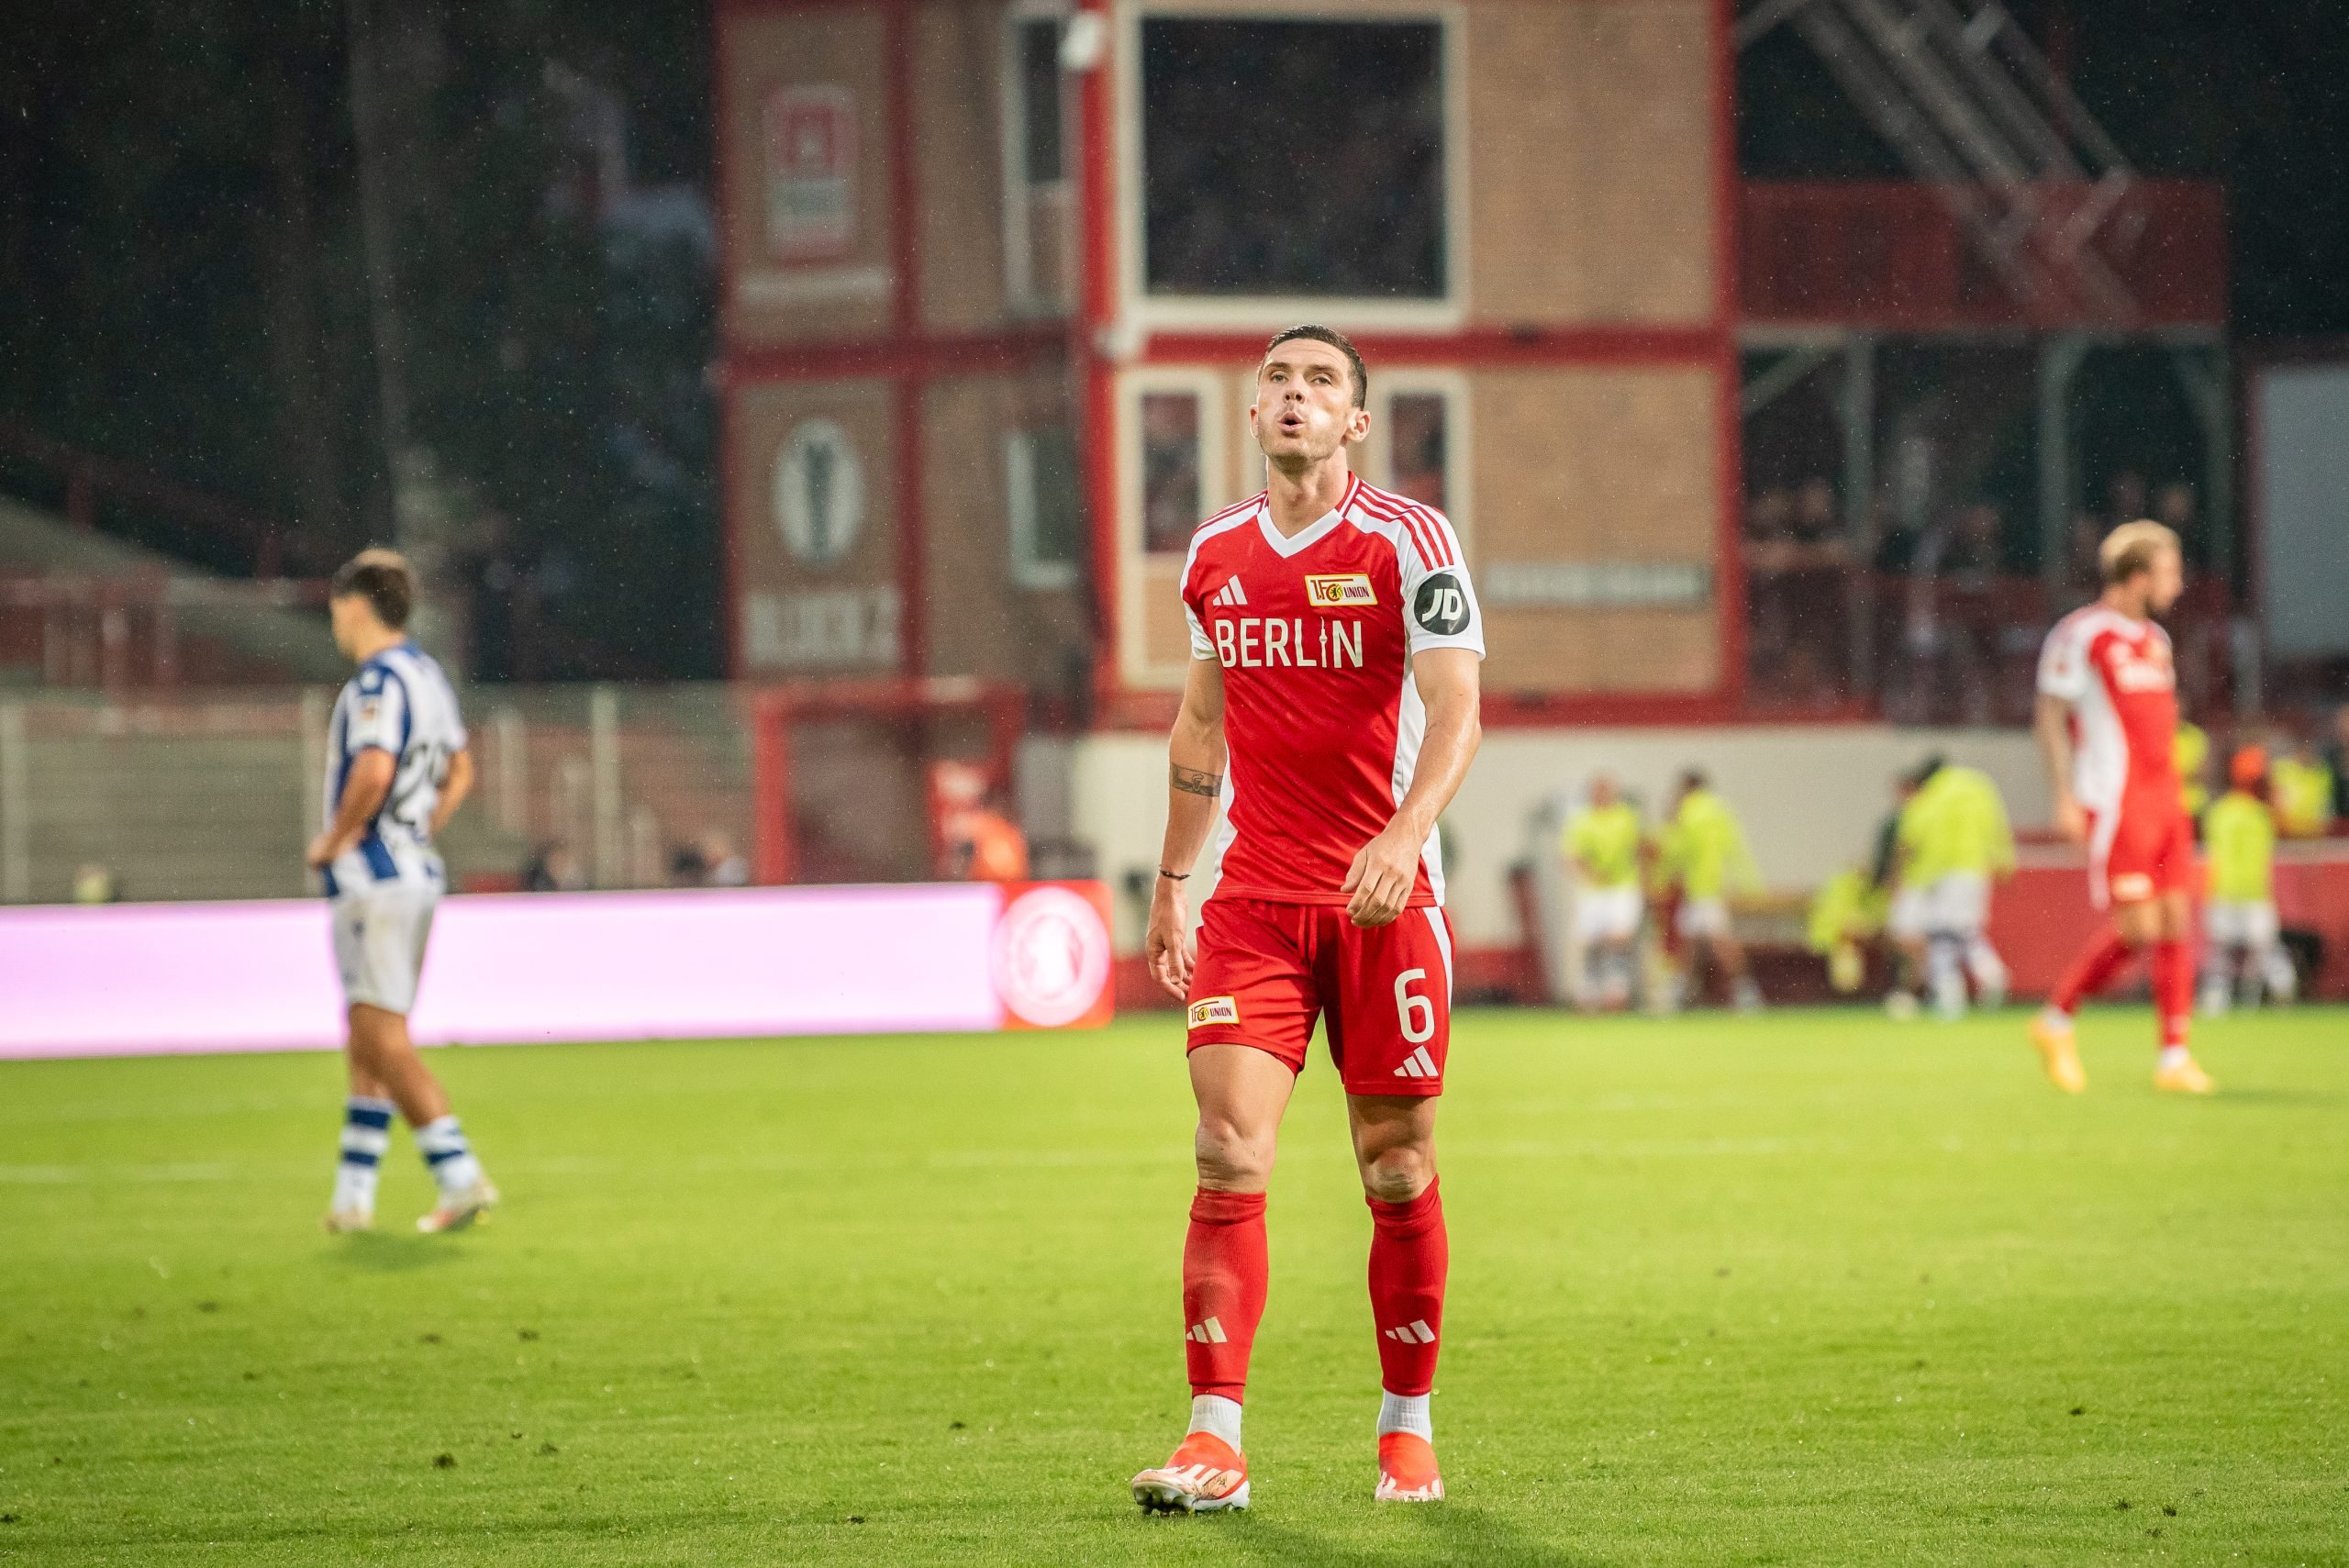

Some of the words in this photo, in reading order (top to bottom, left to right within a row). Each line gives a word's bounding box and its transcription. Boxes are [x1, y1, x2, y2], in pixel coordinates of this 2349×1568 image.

[1343, 586, 1370, 598] UNION
[1421, 587, 1464, 623] JD
[1215, 616, 1364, 668] BERLIN
[1210, 1006, 1232, 1018] UNION
[1394, 968, 1435, 1043] 6
